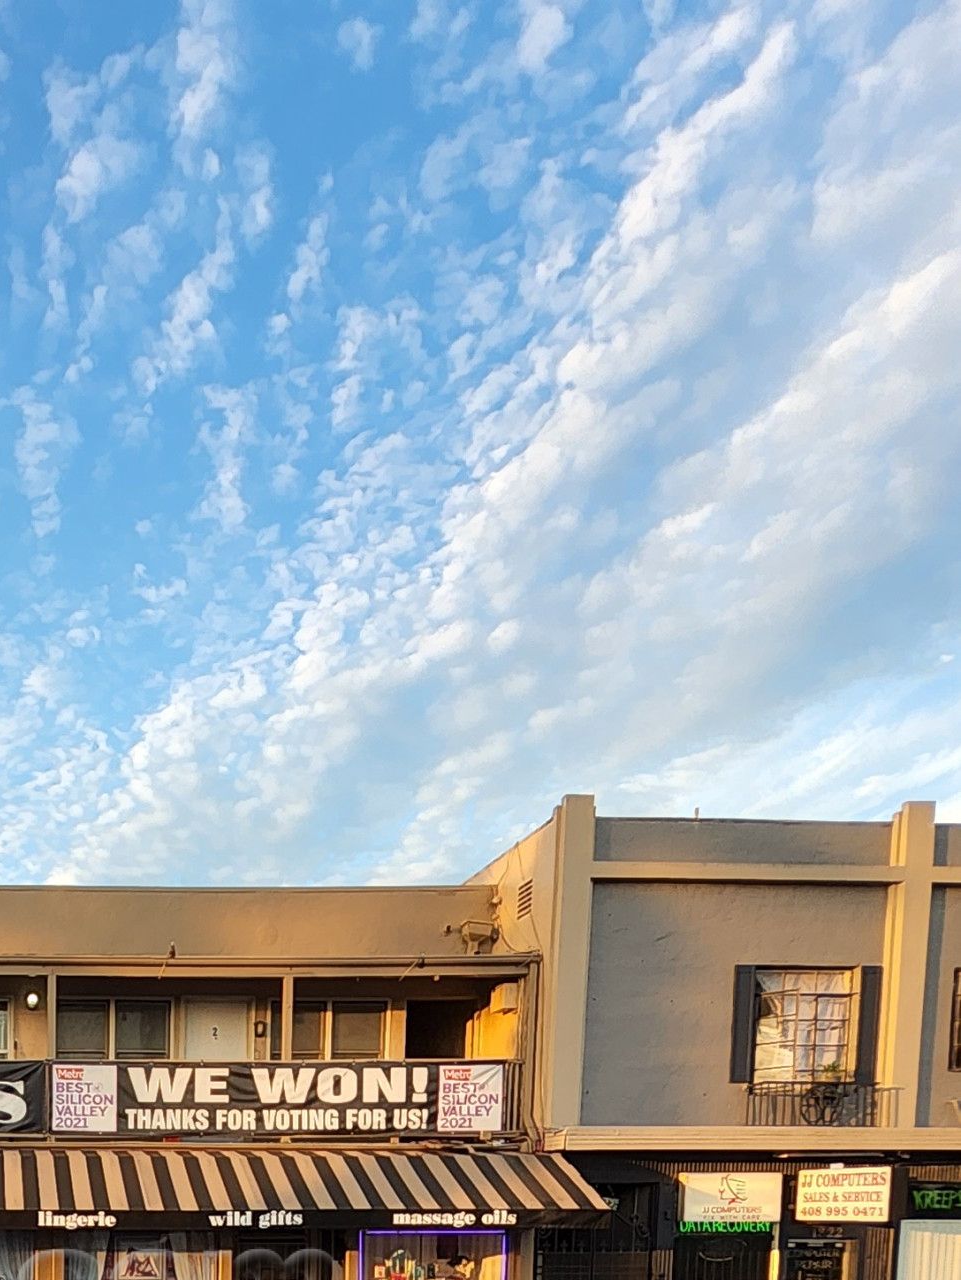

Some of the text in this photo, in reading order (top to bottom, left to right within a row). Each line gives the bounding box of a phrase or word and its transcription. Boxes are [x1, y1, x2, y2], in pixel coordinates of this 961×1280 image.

[56, 1082, 93, 1093] BEST
[127, 1067, 429, 1103] WE WON!
[443, 1083, 479, 1093] BEST
[56, 1094, 114, 1105] SILICON
[442, 1094, 499, 1105] SILICON
[56, 1106, 108, 1117] VALLEY
[442, 1106, 493, 1117] VALLEY
[55, 1117, 88, 1128] 2021
[125, 1107, 428, 1131] THANKS FOR VOTING FOR US!
[440, 1117, 473, 1128] 2021
[801, 1172, 886, 1188] JJ COMPUTERS
[803, 1191, 882, 1203] SALES & SERVICE
[801, 1207, 884, 1217] 408 995 0471
[38, 1210, 117, 1230] lingerie
[209, 1210, 304, 1229] wild gifts
[392, 1210, 518, 1229] massage oils
[712, 1221, 771, 1232] RECOVERY
